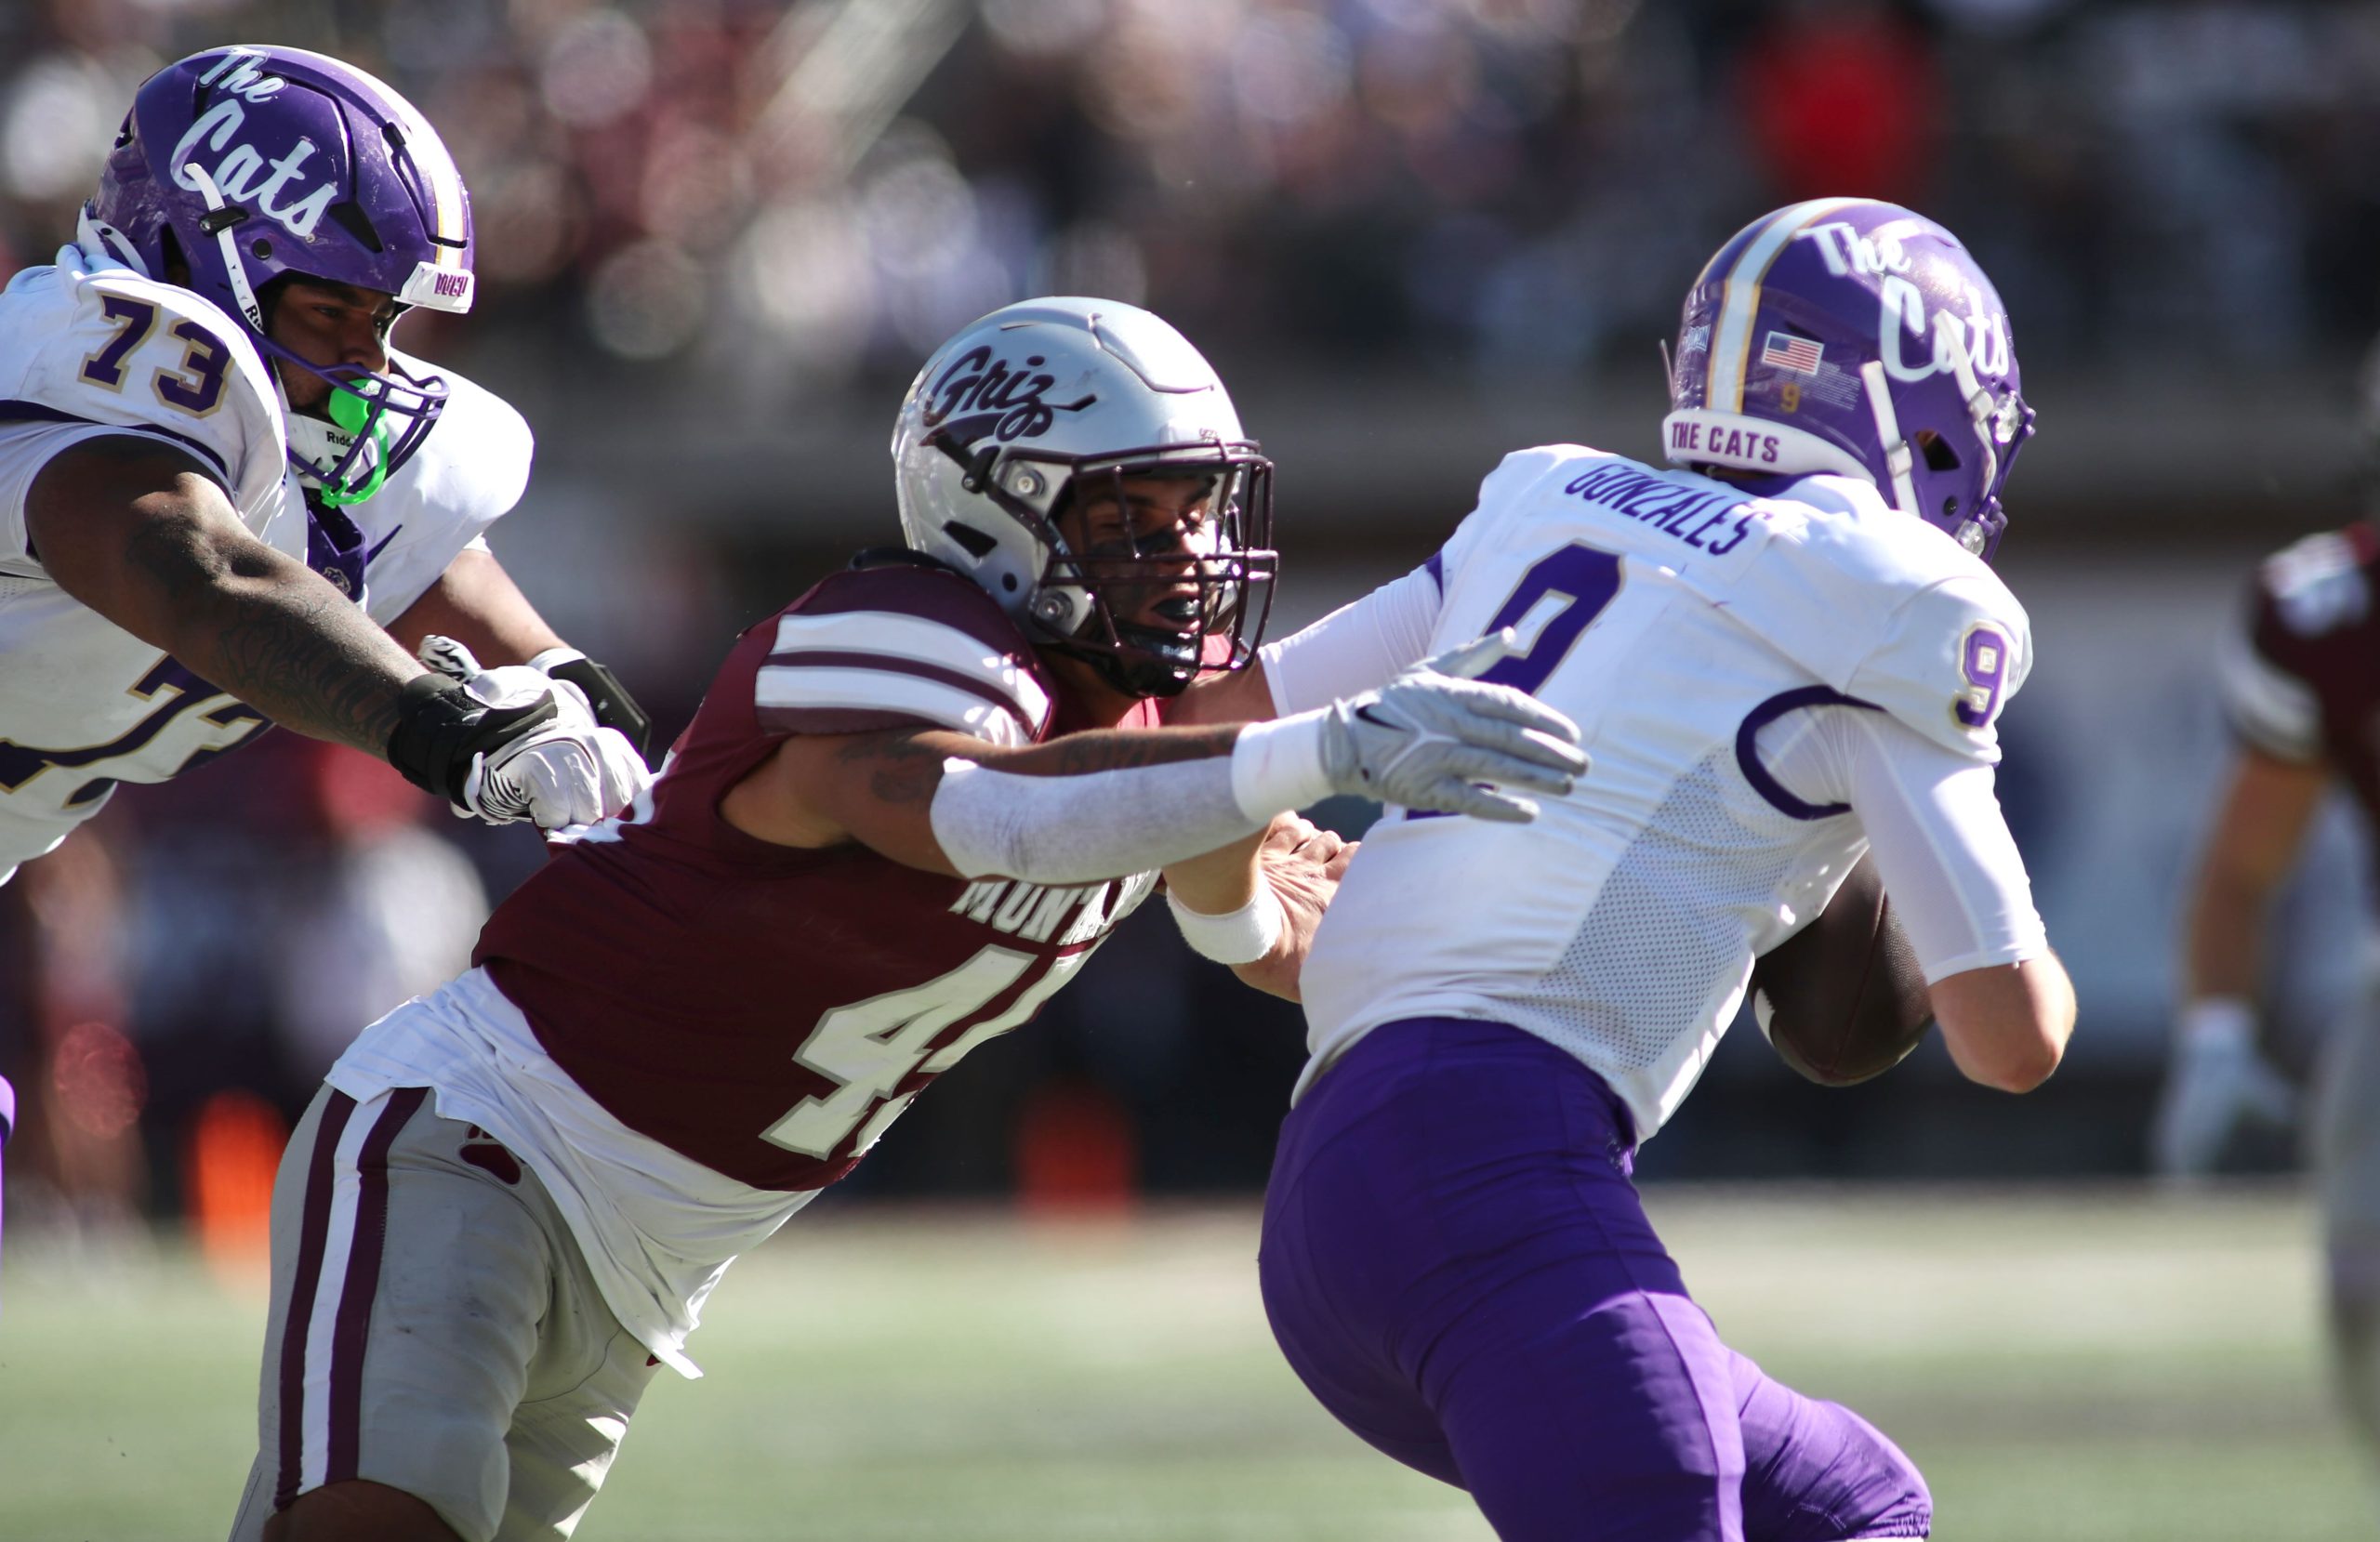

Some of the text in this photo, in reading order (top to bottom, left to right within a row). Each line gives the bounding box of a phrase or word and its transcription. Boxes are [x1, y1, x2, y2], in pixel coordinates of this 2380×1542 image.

[198, 46, 284, 103] The
[170, 99, 338, 237] Cats
[1793, 222, 1912, 276] The
[77, 290, 235, 419] 73
[922, 345, 1097, 442] Griz
[1672, 421, 1780, 463] THE CATS
[1565, 463, 1773, 556] GONZALES
[1949, 620, 2008, 732] 9
